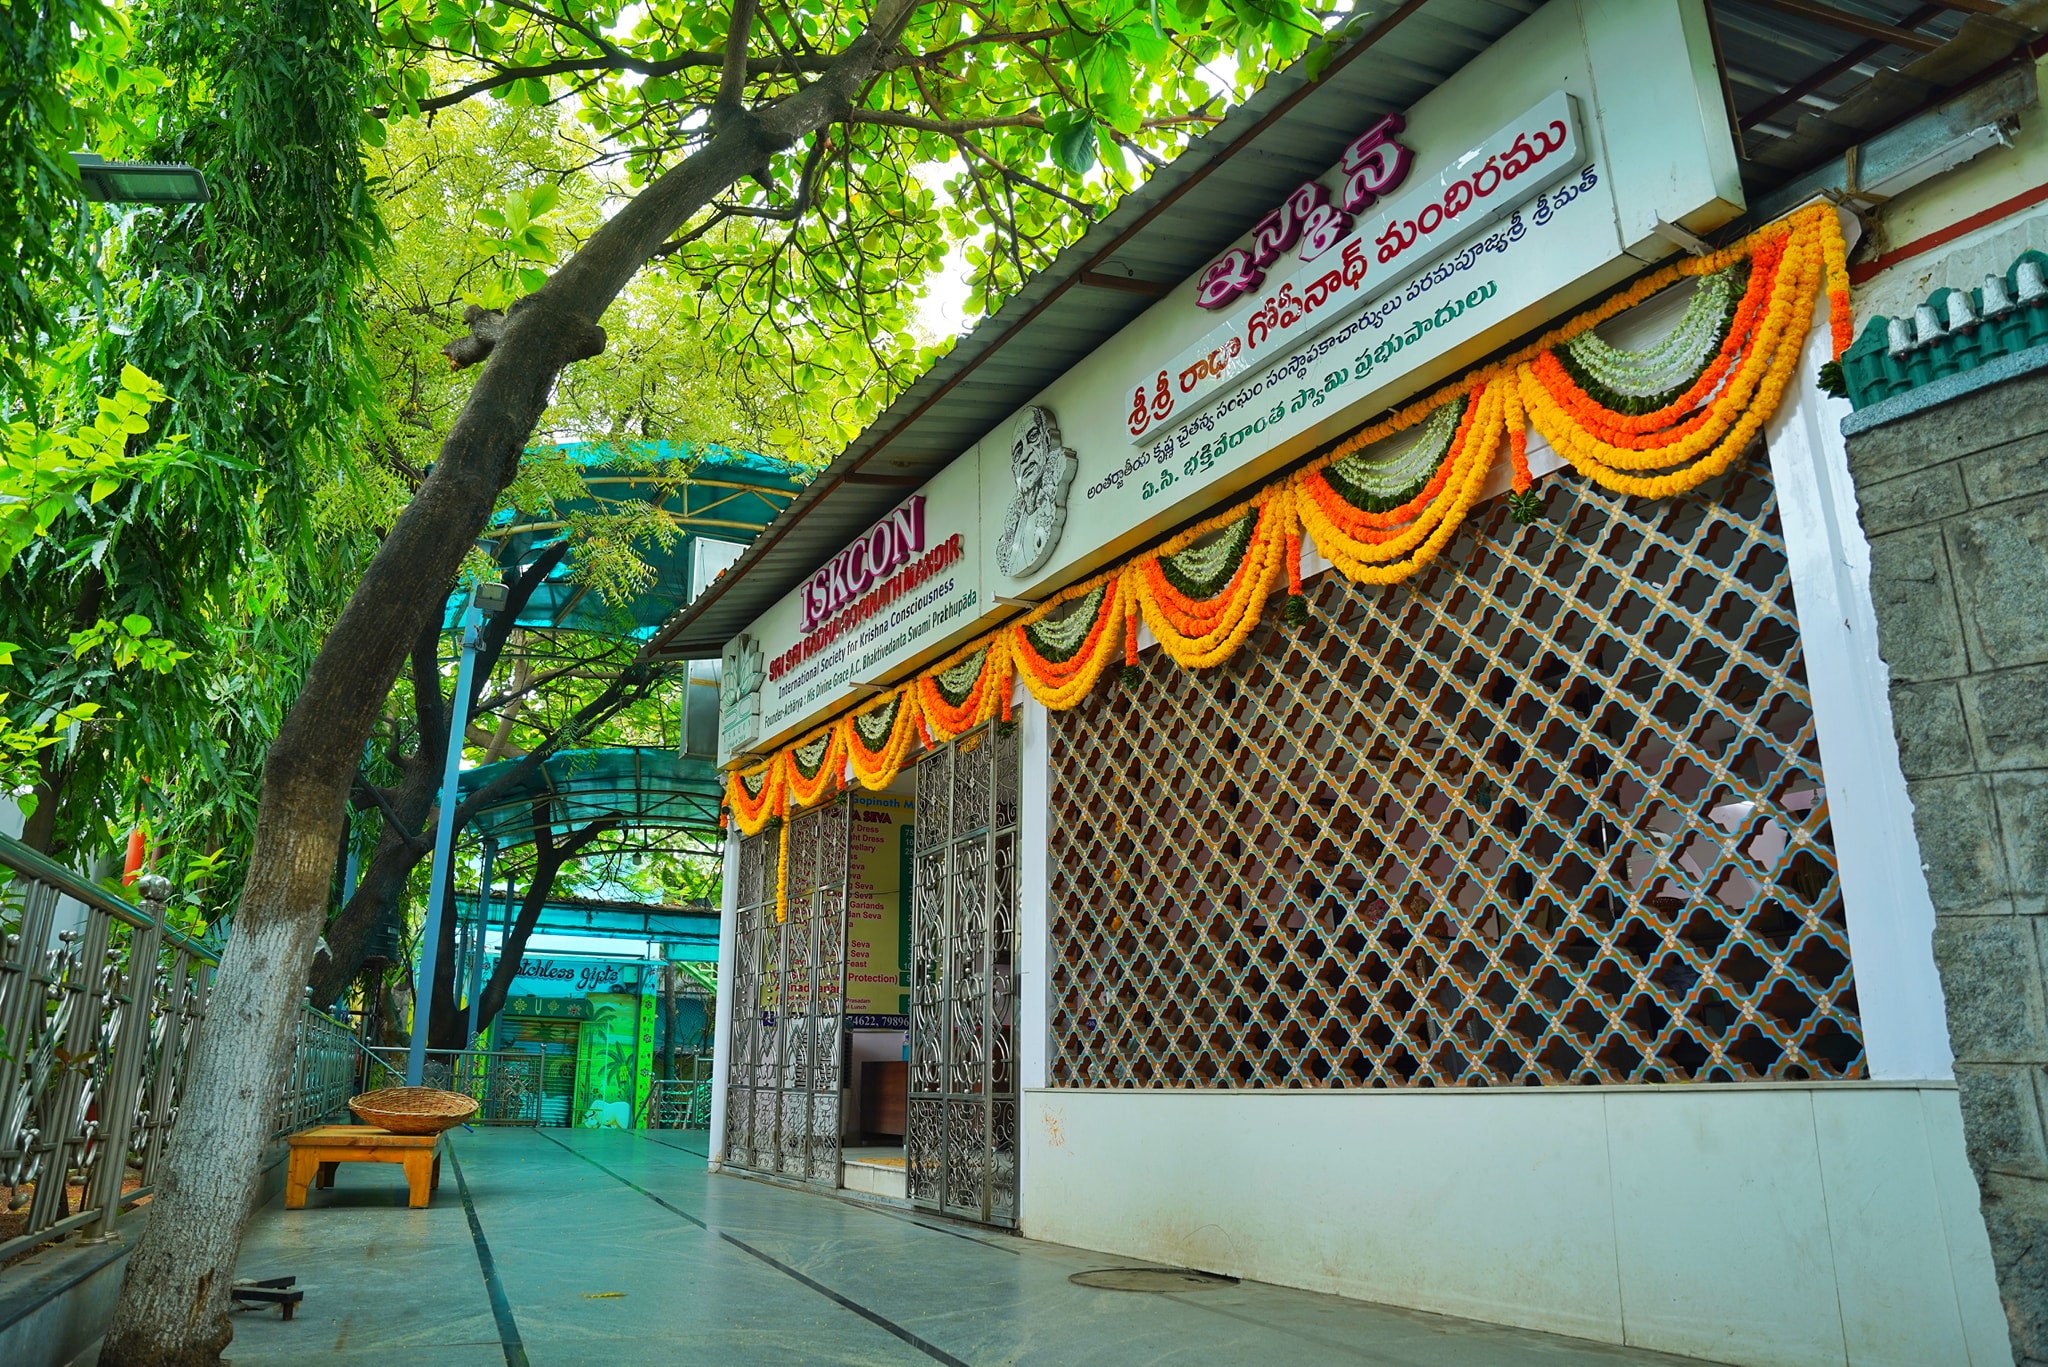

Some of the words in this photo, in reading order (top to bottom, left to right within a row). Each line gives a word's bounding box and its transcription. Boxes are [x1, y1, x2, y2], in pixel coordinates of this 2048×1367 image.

[1179, 337, 1241, 393] రాధా
[1376, 120, 1567, 264] మందిరము
[1291, 368, 1348, 413] స్వామి
[1355, 280, 1497, 380] ప్రభుపాదులు
[1153, 435, 1174, 464] కృష్ణ
[1177, 412, 1215, 447] చైతన్య
[800, 495, 926, 633] ISKCON
[769, 654, 785, 682] SRI
[786, 641, 802, 672] SRI
[803, 620, 840, 660] RADHA
[841, 572, 903, 633] GOPINATH
[904, 533, 962, 592] MANDIR
[779, 662, 819, 699] International
[820, 648, 846, 673] Society
[847, 640, 858, 656] for
[860, 620, 889, 647] Krishna
[890, 577, 954, 627] Consciousness
[816, 679, 832, 699] Divine
[833, 669, 849, 687] Grace
[862, 633, 906, 671] Bhaktivedanta
[908, 615, 931, 643] Swami
[863, 810, 892, 824] SEVA
[857, 825, 879, 833] Dress
[863, 834, 885, 843] Dress
[854, 882, 874, 890] Seva
[854, 891, 873, 900] Seva
[849, 901, 884, 910] Garlands
[863, 911, 882, 919] Seva
[851, 939, 871, 948] Seva
[850, 949, 870, 958] Seva
[505, 958, 574, 979] atchless
[848, 973, 898, 985] Protection)
